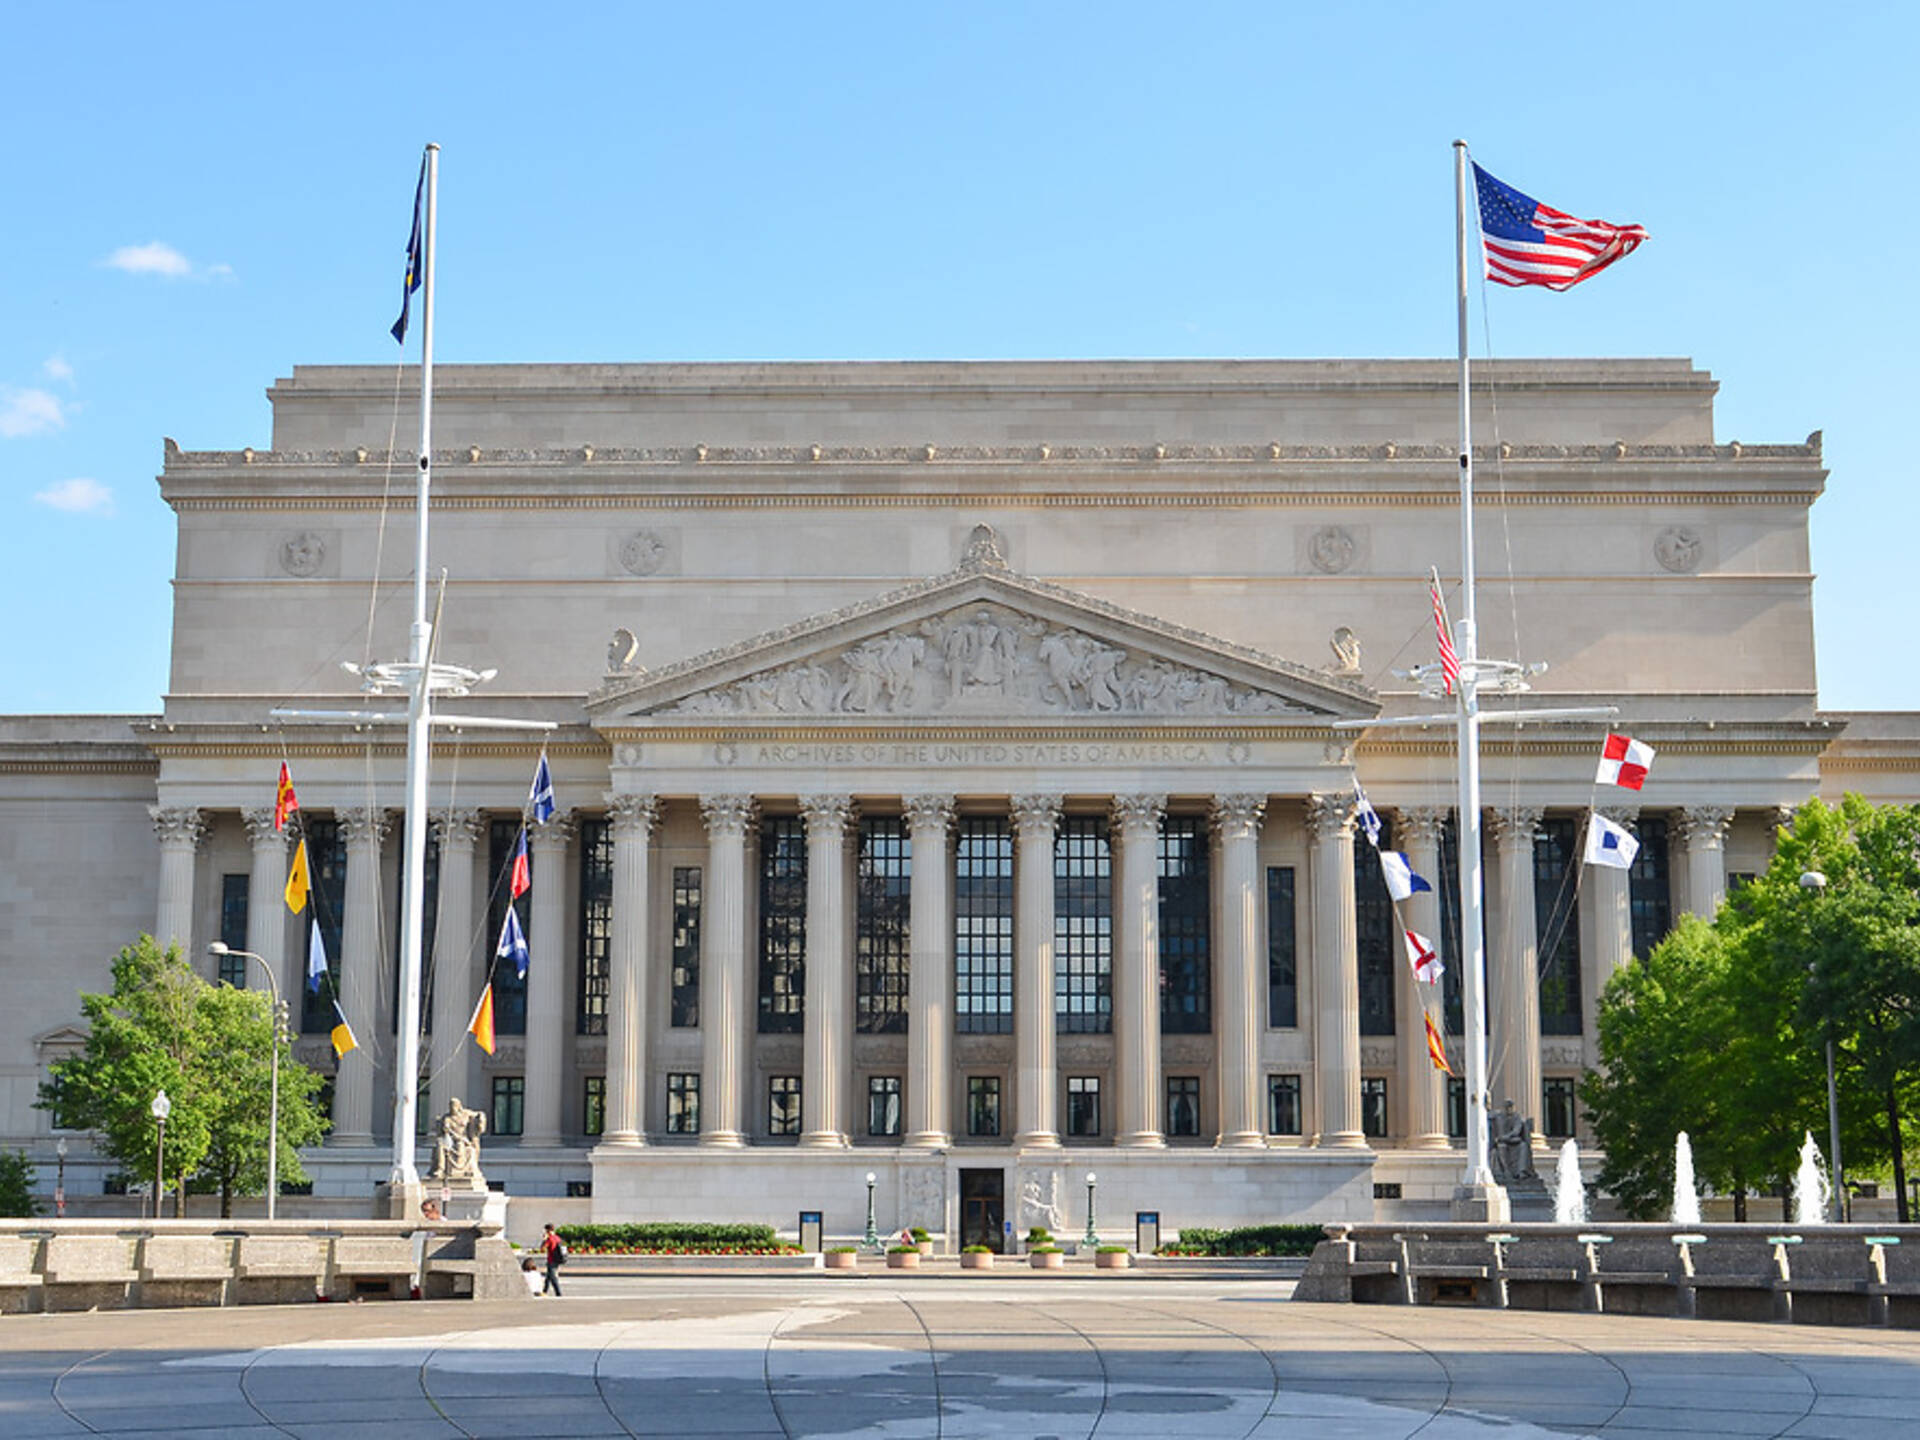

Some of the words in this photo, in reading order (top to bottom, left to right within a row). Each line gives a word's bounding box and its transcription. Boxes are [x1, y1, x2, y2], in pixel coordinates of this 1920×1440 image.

[758, 745, 857, 762] ARCHIVES
[861, 745, 887, 762] OF
[891, 745, 928, 762] THE
[934, 745, 1007, 762] UNITED
[1013, 745, 1080, 762] STATES
[1086, 745, 1111, 762] OF
[1116, 745, 1207, 762] AMERICA
